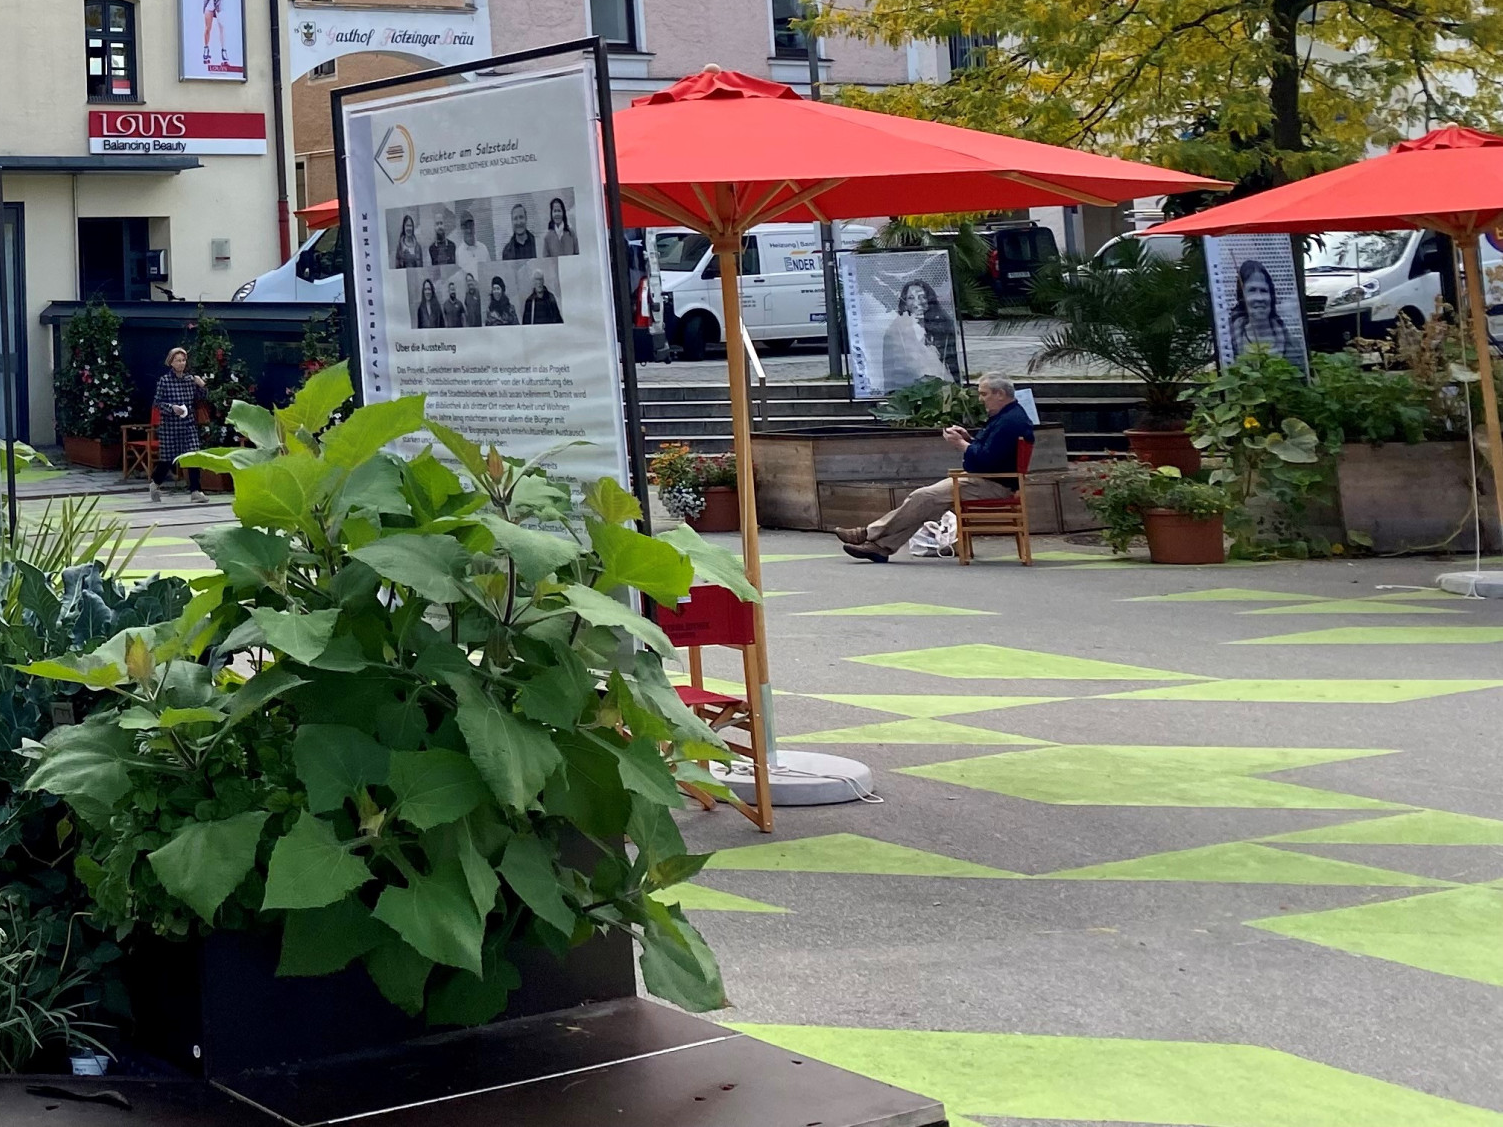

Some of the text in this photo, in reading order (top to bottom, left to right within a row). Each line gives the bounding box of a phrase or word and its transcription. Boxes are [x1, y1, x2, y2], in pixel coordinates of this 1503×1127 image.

[326, 26, 474, 46] Gasthof Flötzinger Bräu
[99, 112, 186, 136] LOUYS
[104, 140, 187, 153] Balancing Beauty
[784, 257, 816, 272] ENDER
[396, 342, 456, 354] Über die Ausstellung
